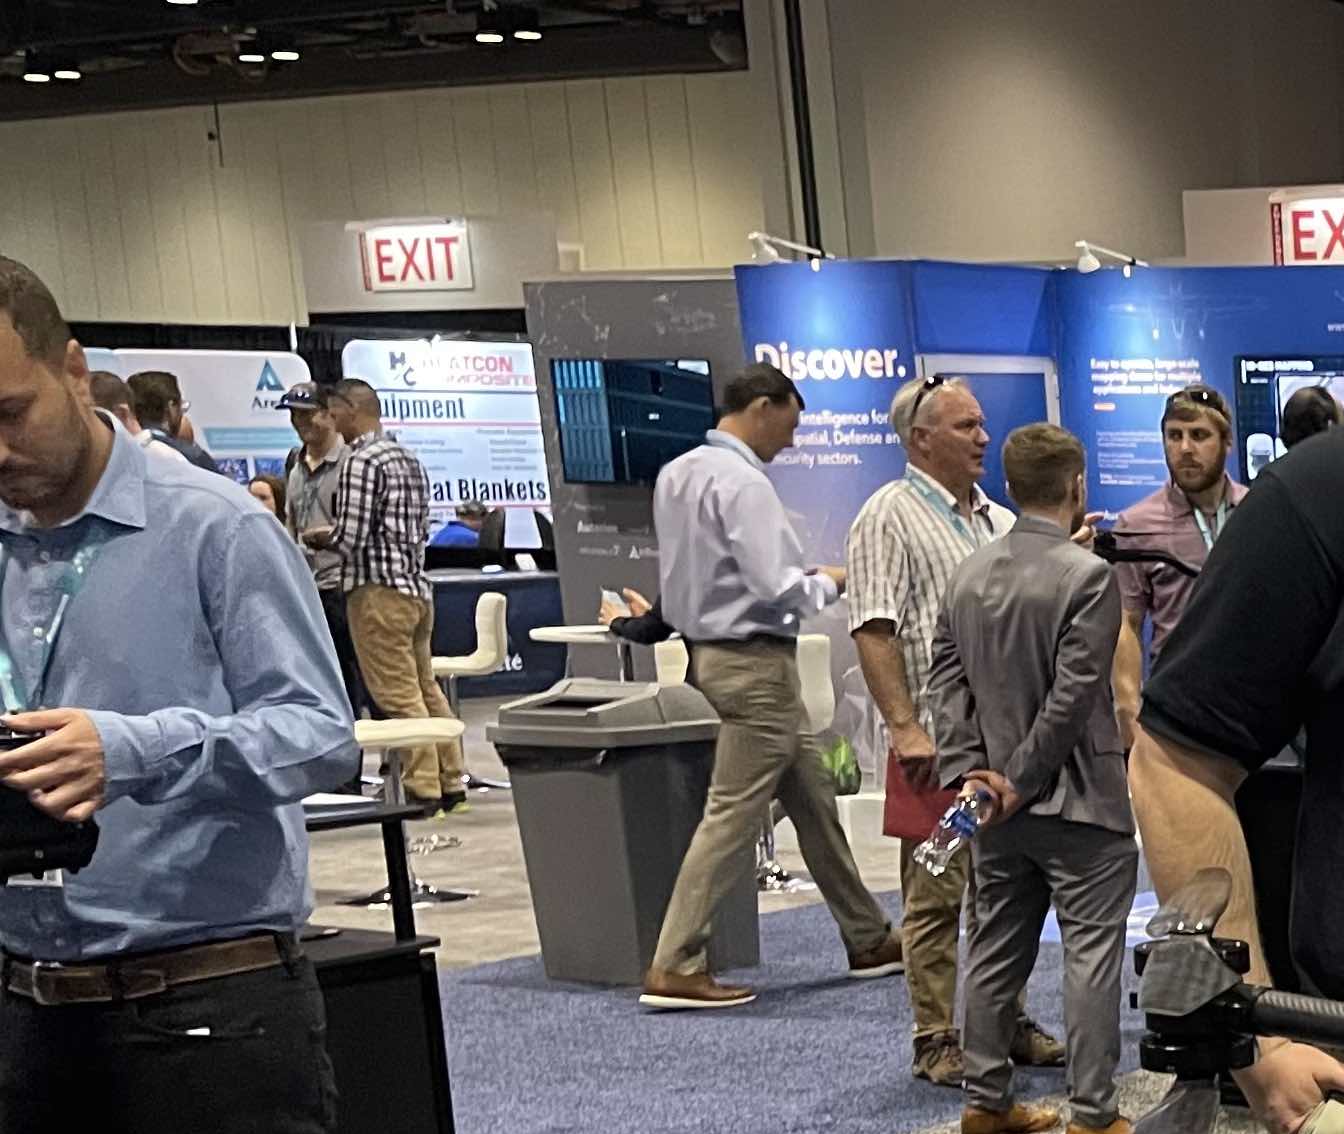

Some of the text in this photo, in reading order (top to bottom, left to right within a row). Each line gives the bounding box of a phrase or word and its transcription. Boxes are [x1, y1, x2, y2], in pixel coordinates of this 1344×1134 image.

[375, 236, 459, 282] EXIT
[754, 342, 906, 379] Discover.
[381, 393, 466, 422] uipment
[871, 409, 889, 424] for
[833, 429, 882, 445] Defense
[885, 433, 900, 444] an
[433, 478, 547, 501] at Blankets
